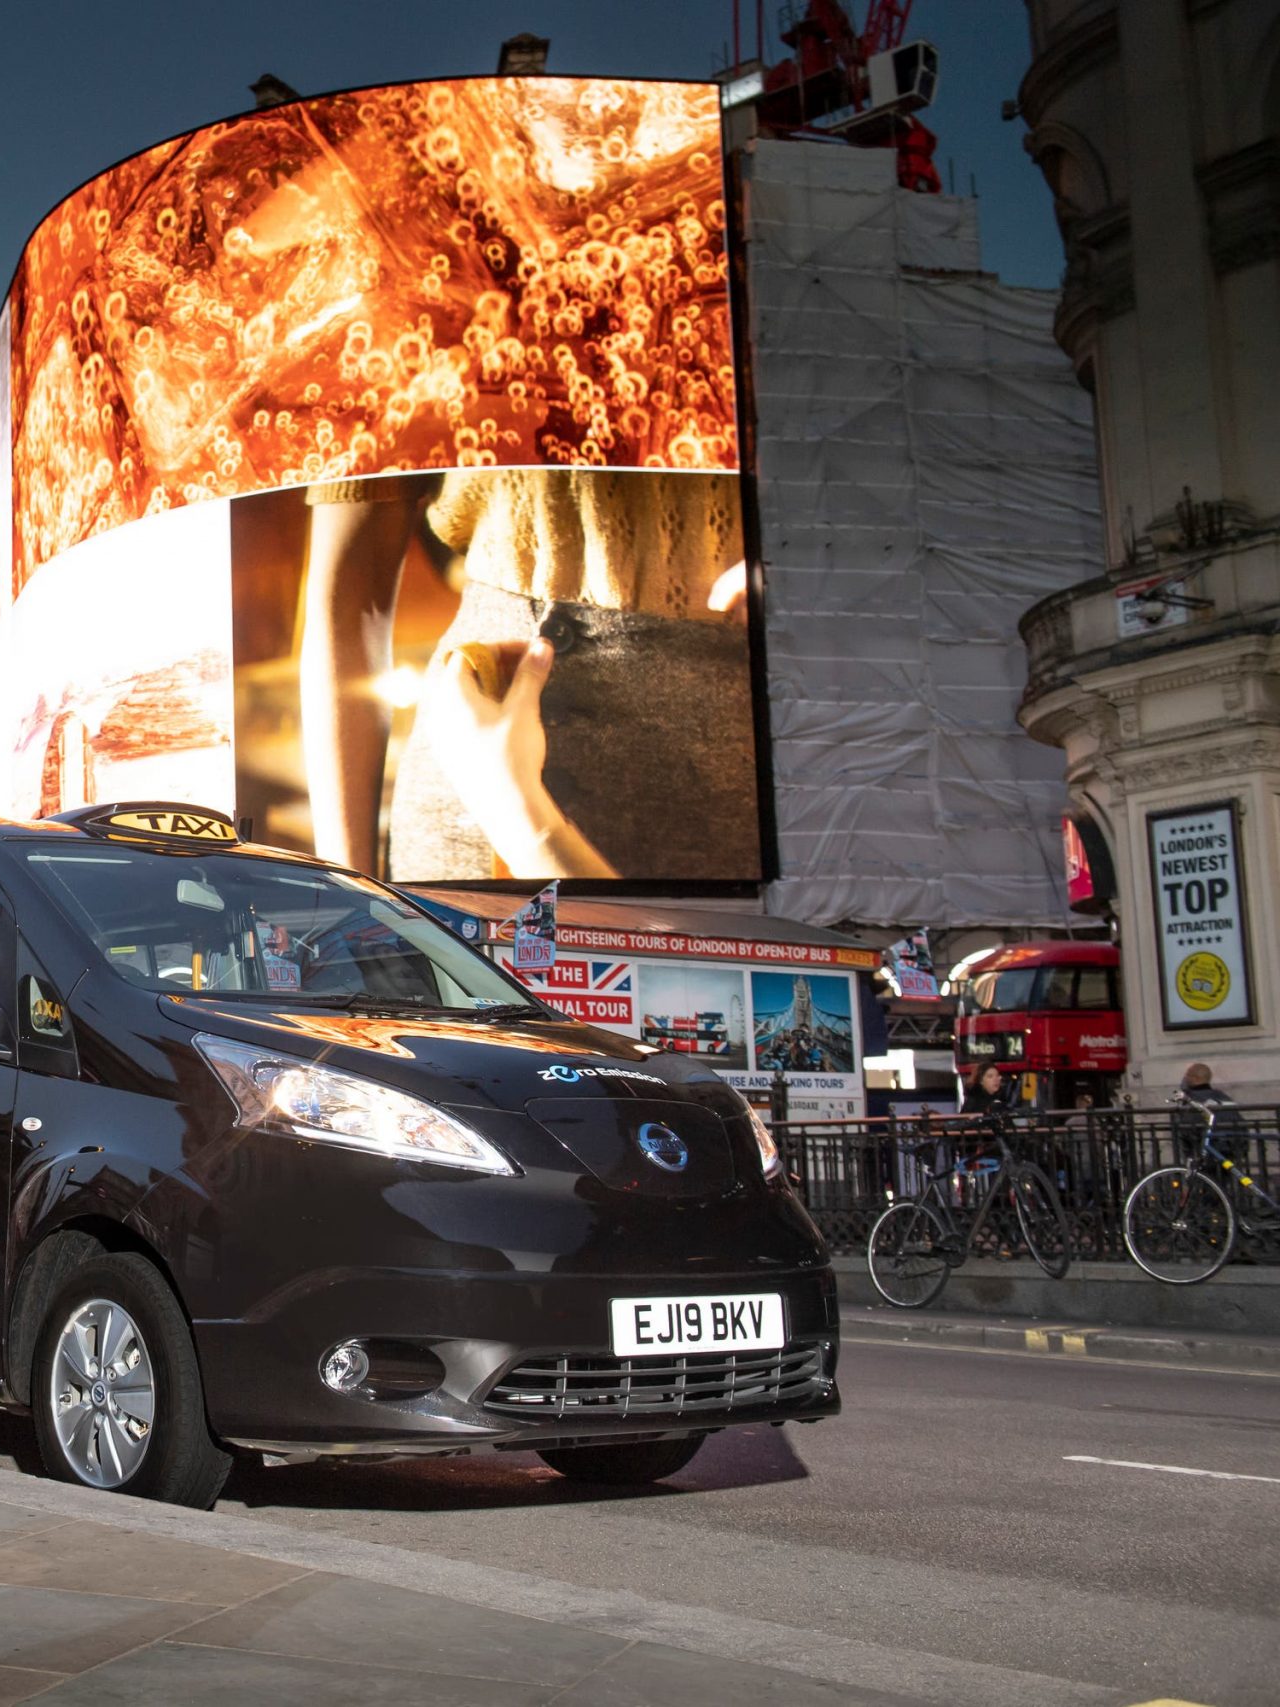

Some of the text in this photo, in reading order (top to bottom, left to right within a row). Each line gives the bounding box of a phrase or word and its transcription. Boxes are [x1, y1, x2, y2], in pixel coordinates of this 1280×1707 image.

[136, 814, 228, 838] TAXI
[1160, 834, 1228, 855] LONDON'S
[1161, 854, 1229, 877] NEWEST
[1163, 877, 1230, 916] TOP
[1166, 918, 1233, 936] ATTRACTION
[555, 928, 626, 947] IGHTSEEING
[629, 934, 667, 950] TOURS
[670, 937, 685, 952] OF
[688, 938, 736, 954] LONDON
[738, 942, 753, 956] BY
[755, 944, 808, 960] OPEN-TOP
[810, 949, 831, 962] BUS
[553, 966, 584, 982] THE
[587, 1001, 629, 1017] TOUR
[1007, 1036, 1023, 1056] 24
[596, 1067, 668, 1086] Emission
[748, 1077, 768, 1088] AND
[815, 1078, 845, 1090] TOURS
[634, 1300, 763, 1345] EJ19 BKV
